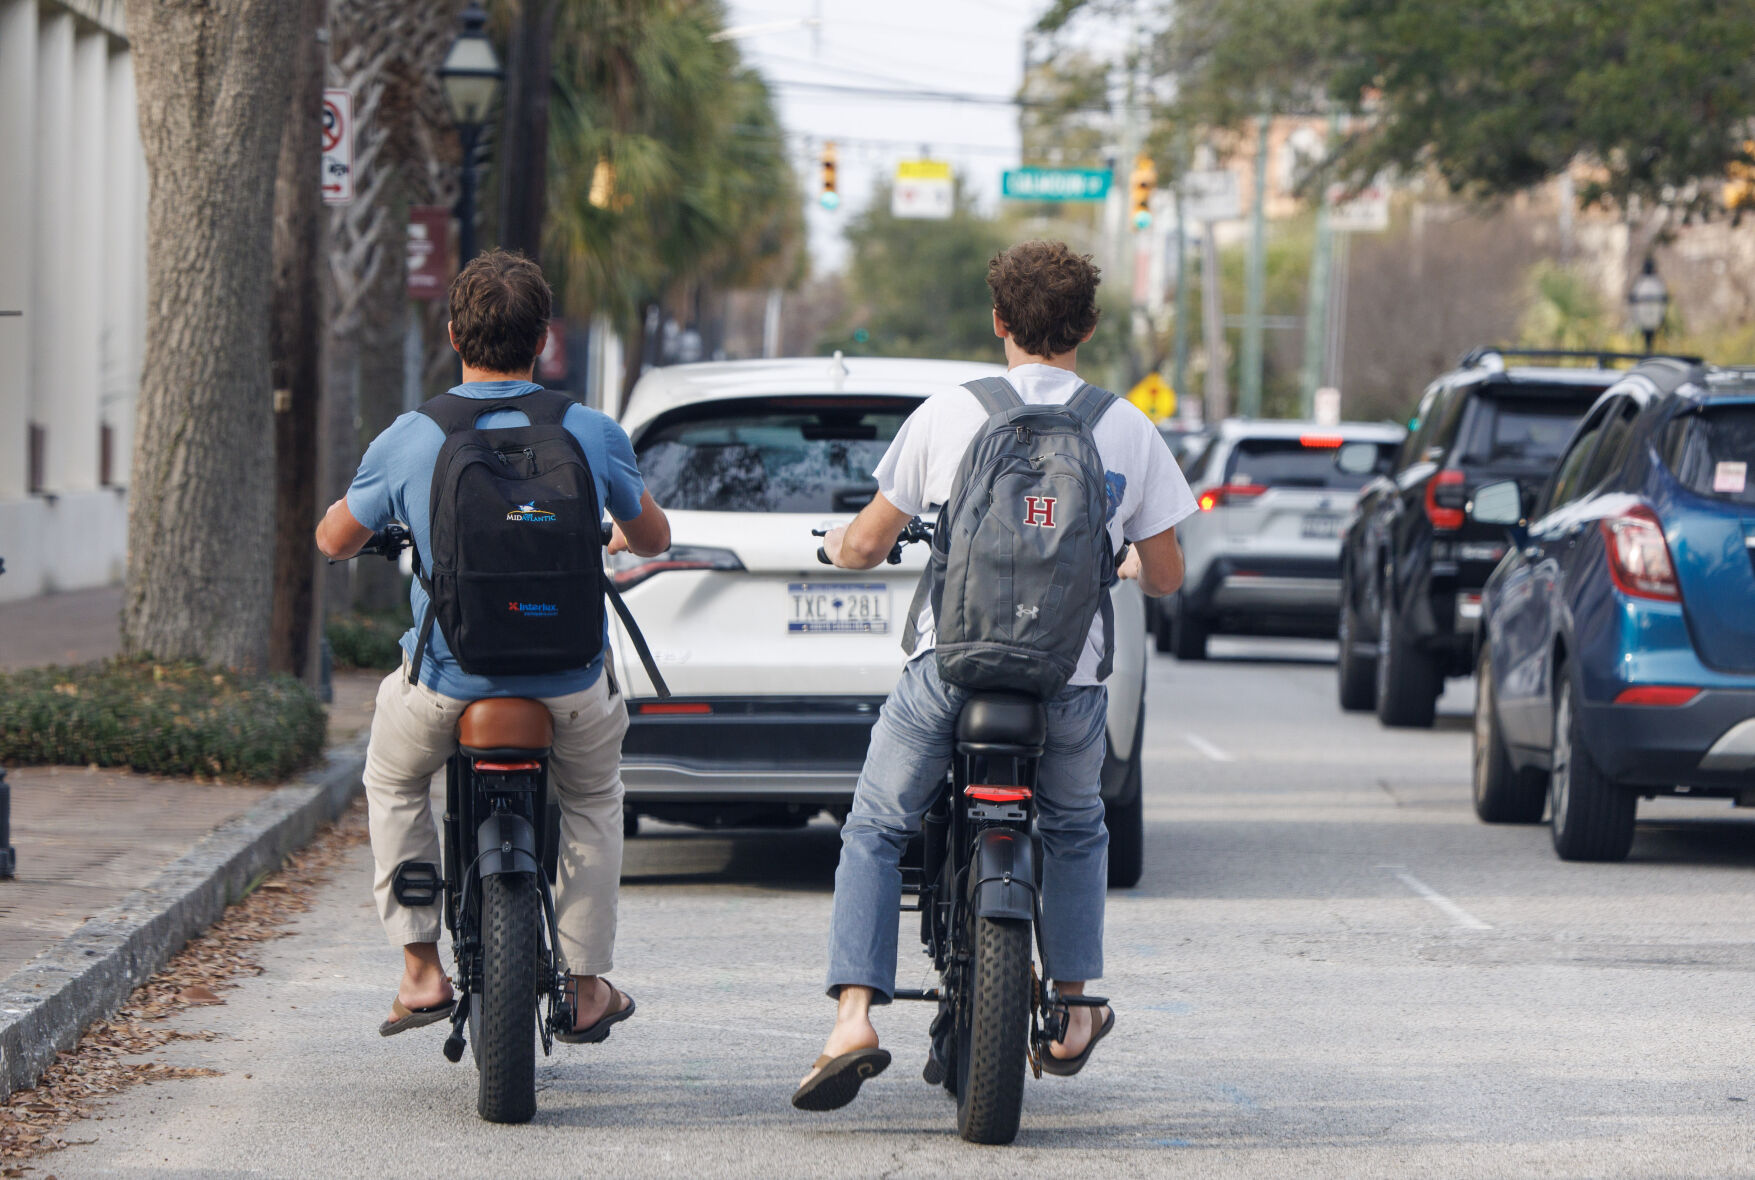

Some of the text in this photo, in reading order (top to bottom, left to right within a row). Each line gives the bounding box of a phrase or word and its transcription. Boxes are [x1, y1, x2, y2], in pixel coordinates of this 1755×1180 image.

[1023, 496, 1056, 528] H
[793, 595, 881, 618] TXC 281
